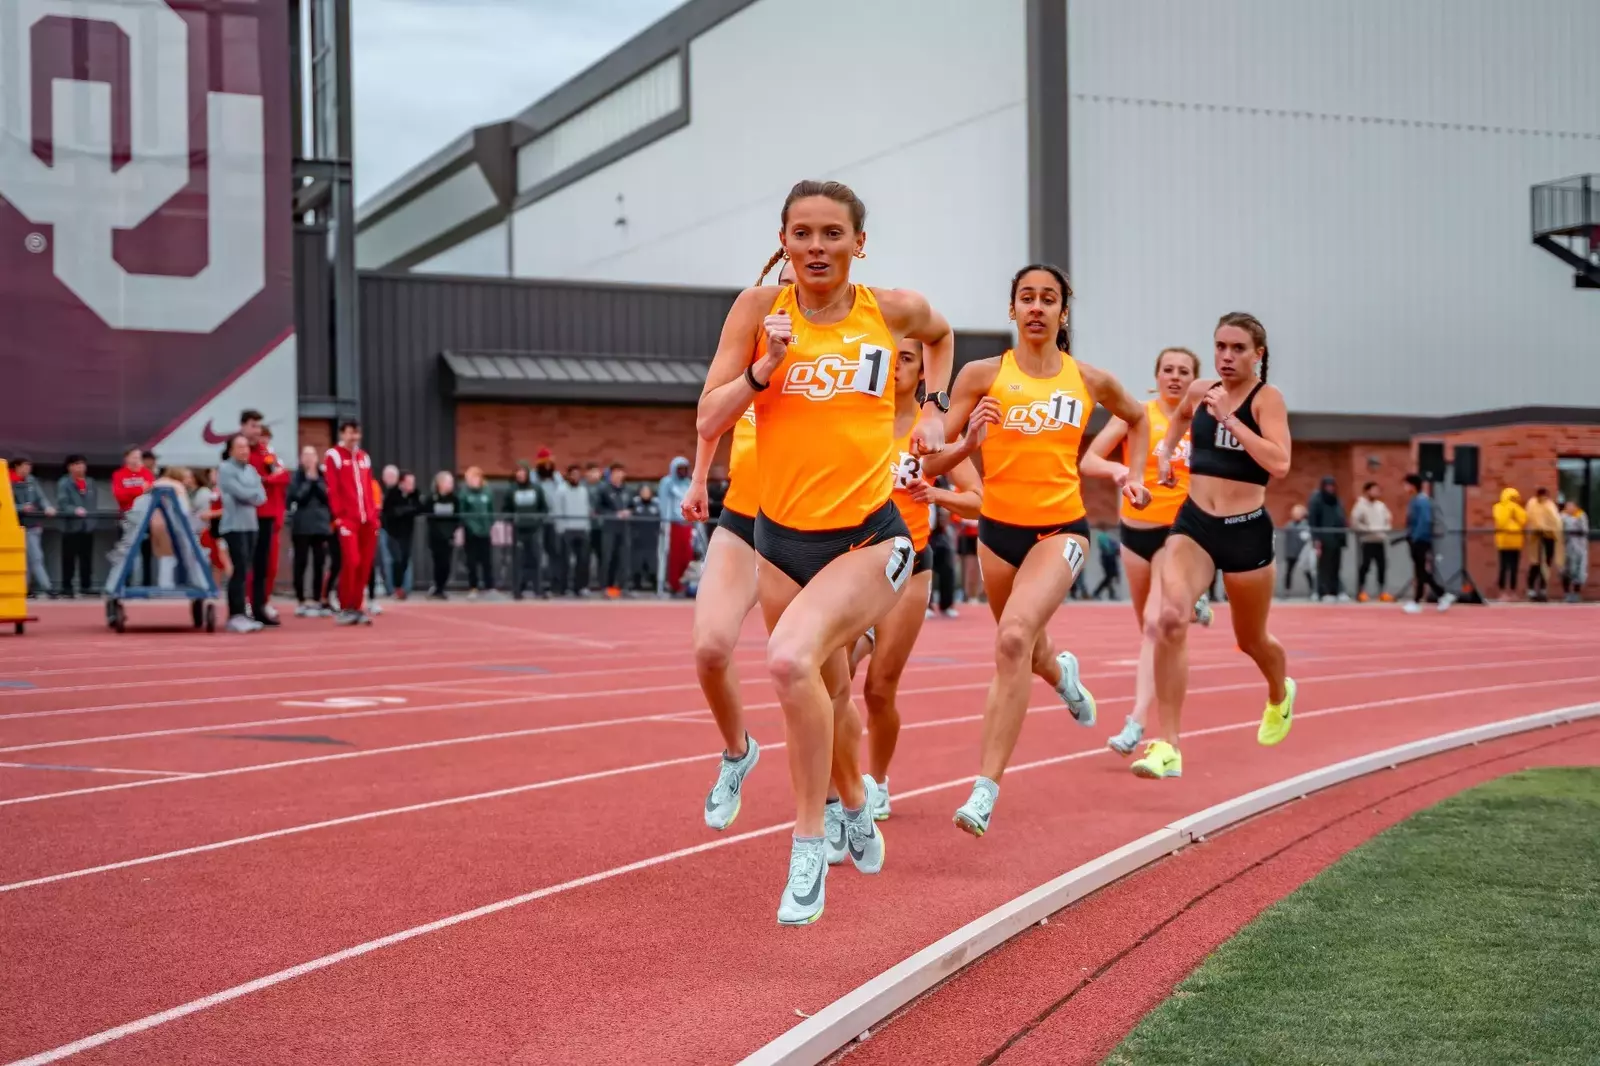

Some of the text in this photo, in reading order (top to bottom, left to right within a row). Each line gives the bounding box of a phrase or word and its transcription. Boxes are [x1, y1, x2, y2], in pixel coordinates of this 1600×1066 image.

[865, 349, 883, 392] 1
[1053, 396, 1076, 423] 11
[901, 458, 920, 487] 3
[1224, 515, 1247, 525] NIKE
[891, 546, 911, 583] 1
[1068, 541, 1083, 571] 11
